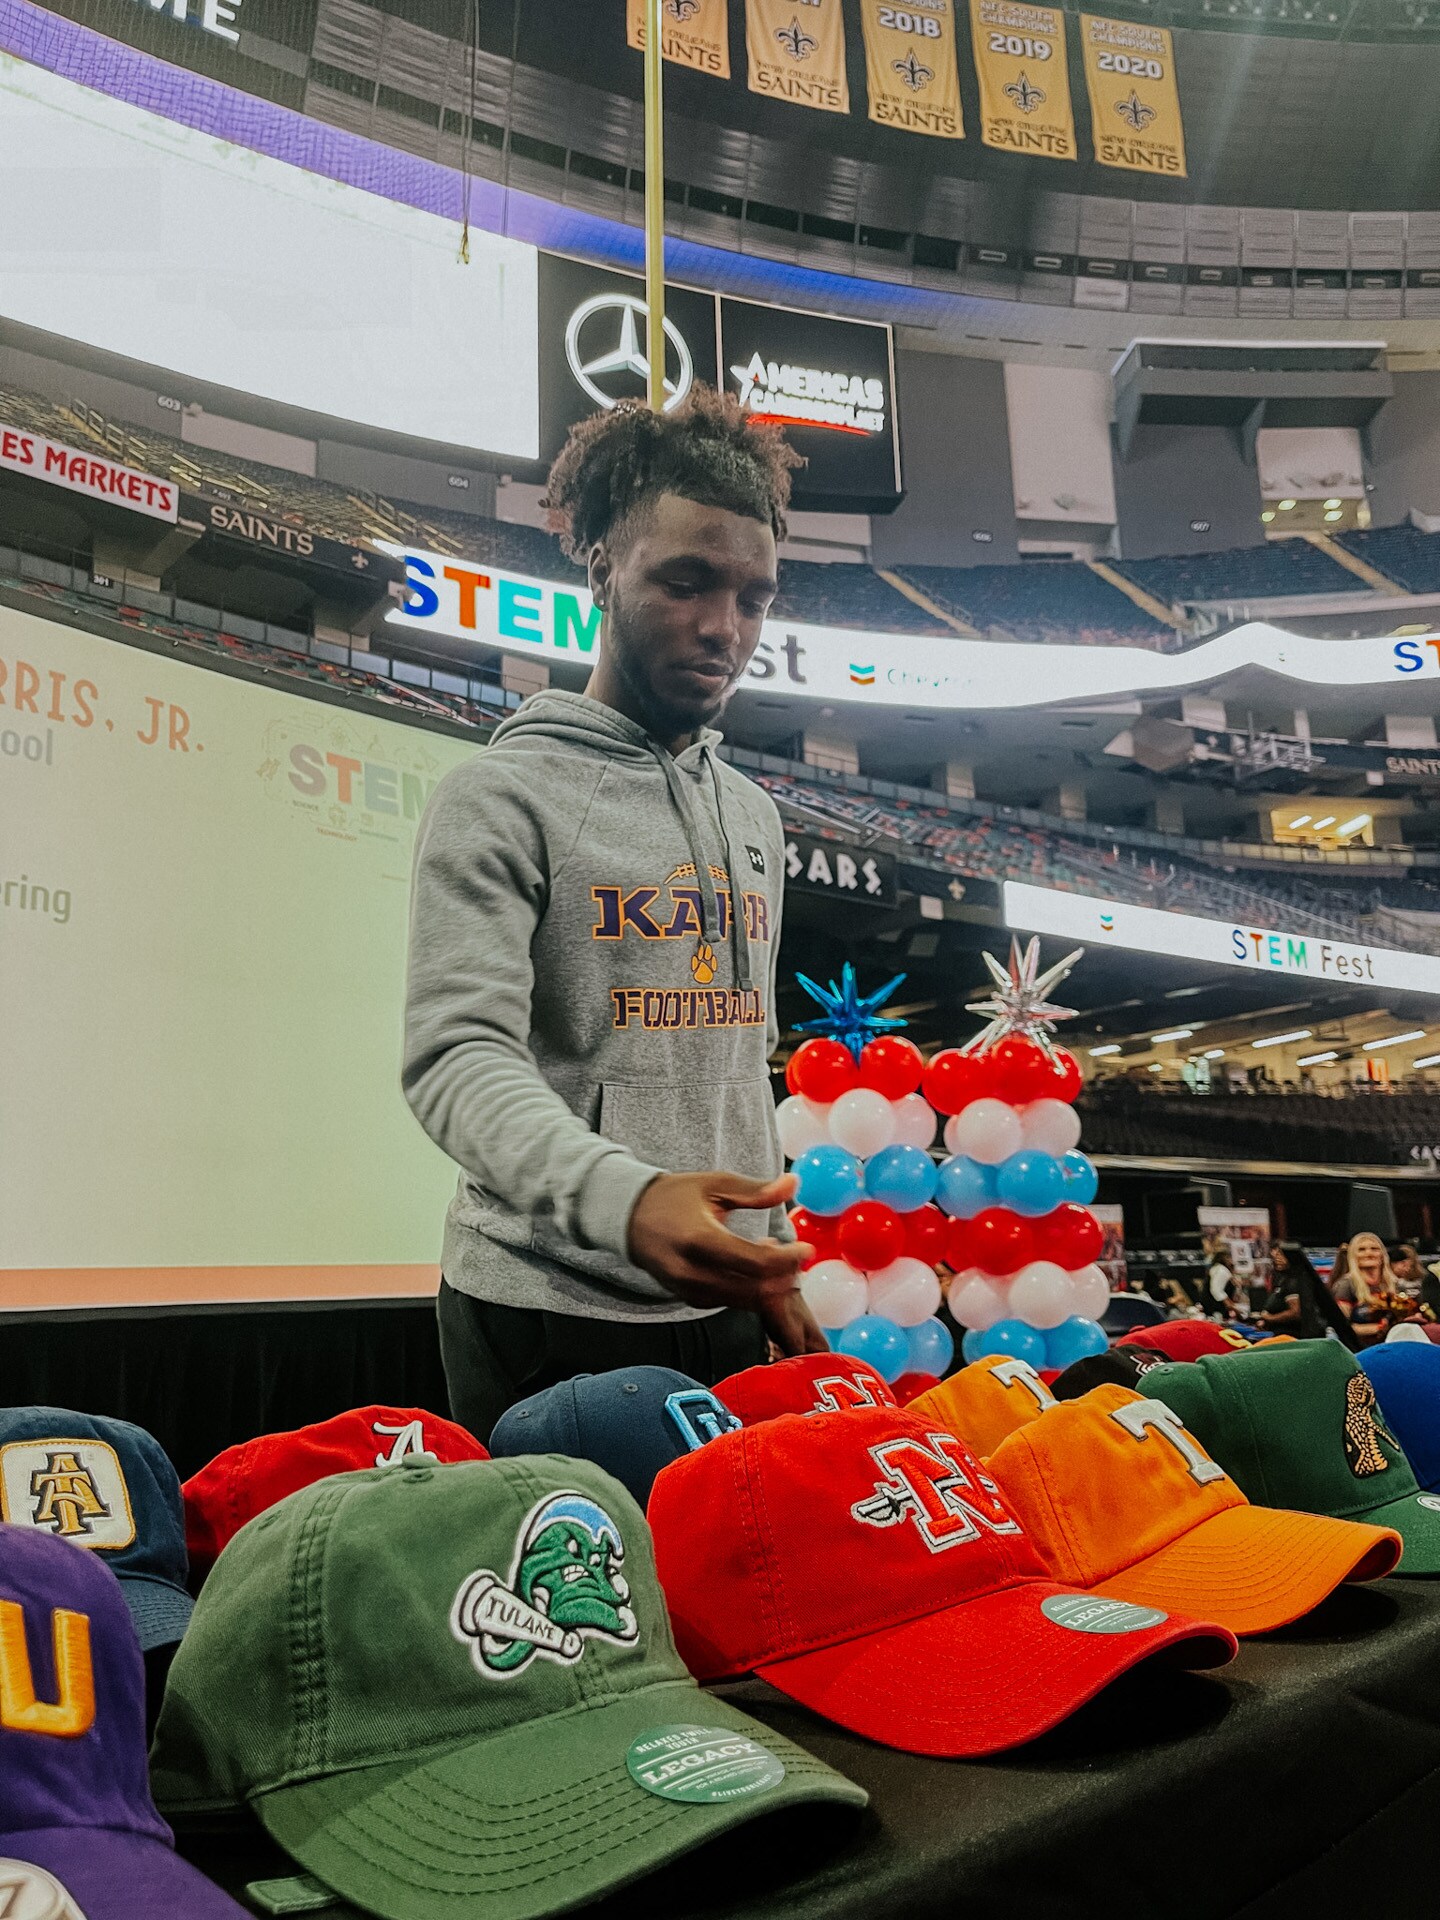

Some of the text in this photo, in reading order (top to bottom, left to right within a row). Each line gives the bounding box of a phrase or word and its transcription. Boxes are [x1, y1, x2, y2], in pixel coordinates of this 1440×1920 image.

[878, 7, 942, 38] 2018
[637, 28, 722, 71] SINTS
[988, 33, 1053, 62] 2019
[1098, 51, 1164, 80] 2020
[757, 70, 842, 106] SAINTS
[875, 102, 958, 135] SAINTS
[987, 127, 1070, 155] SAINTS
[1101, 144, 1181, 172] SAINTS
[2, 431, 172, 512] ES MARKETS
[210, 505, 314, 555] SAINTS
[404, 555, 602, 653] STEM
[137, 696, 204, 752] JR.
[1386, 756, 1440, 775] SAINT
[0, 874, 71, 923] ring
[1232, 929, 1374, 980] STEM Fest
[611, 986, 767, 1030] FOOTBALL
[1109, 1398, 1225, 1488] T
[0, 1600, 96, 1739] U
[635, 1733, 681, 1753] RELAXED
[641, 1742, 757, 1785] LEGACY
[665, 1737, 700, 1751] YOUTH
